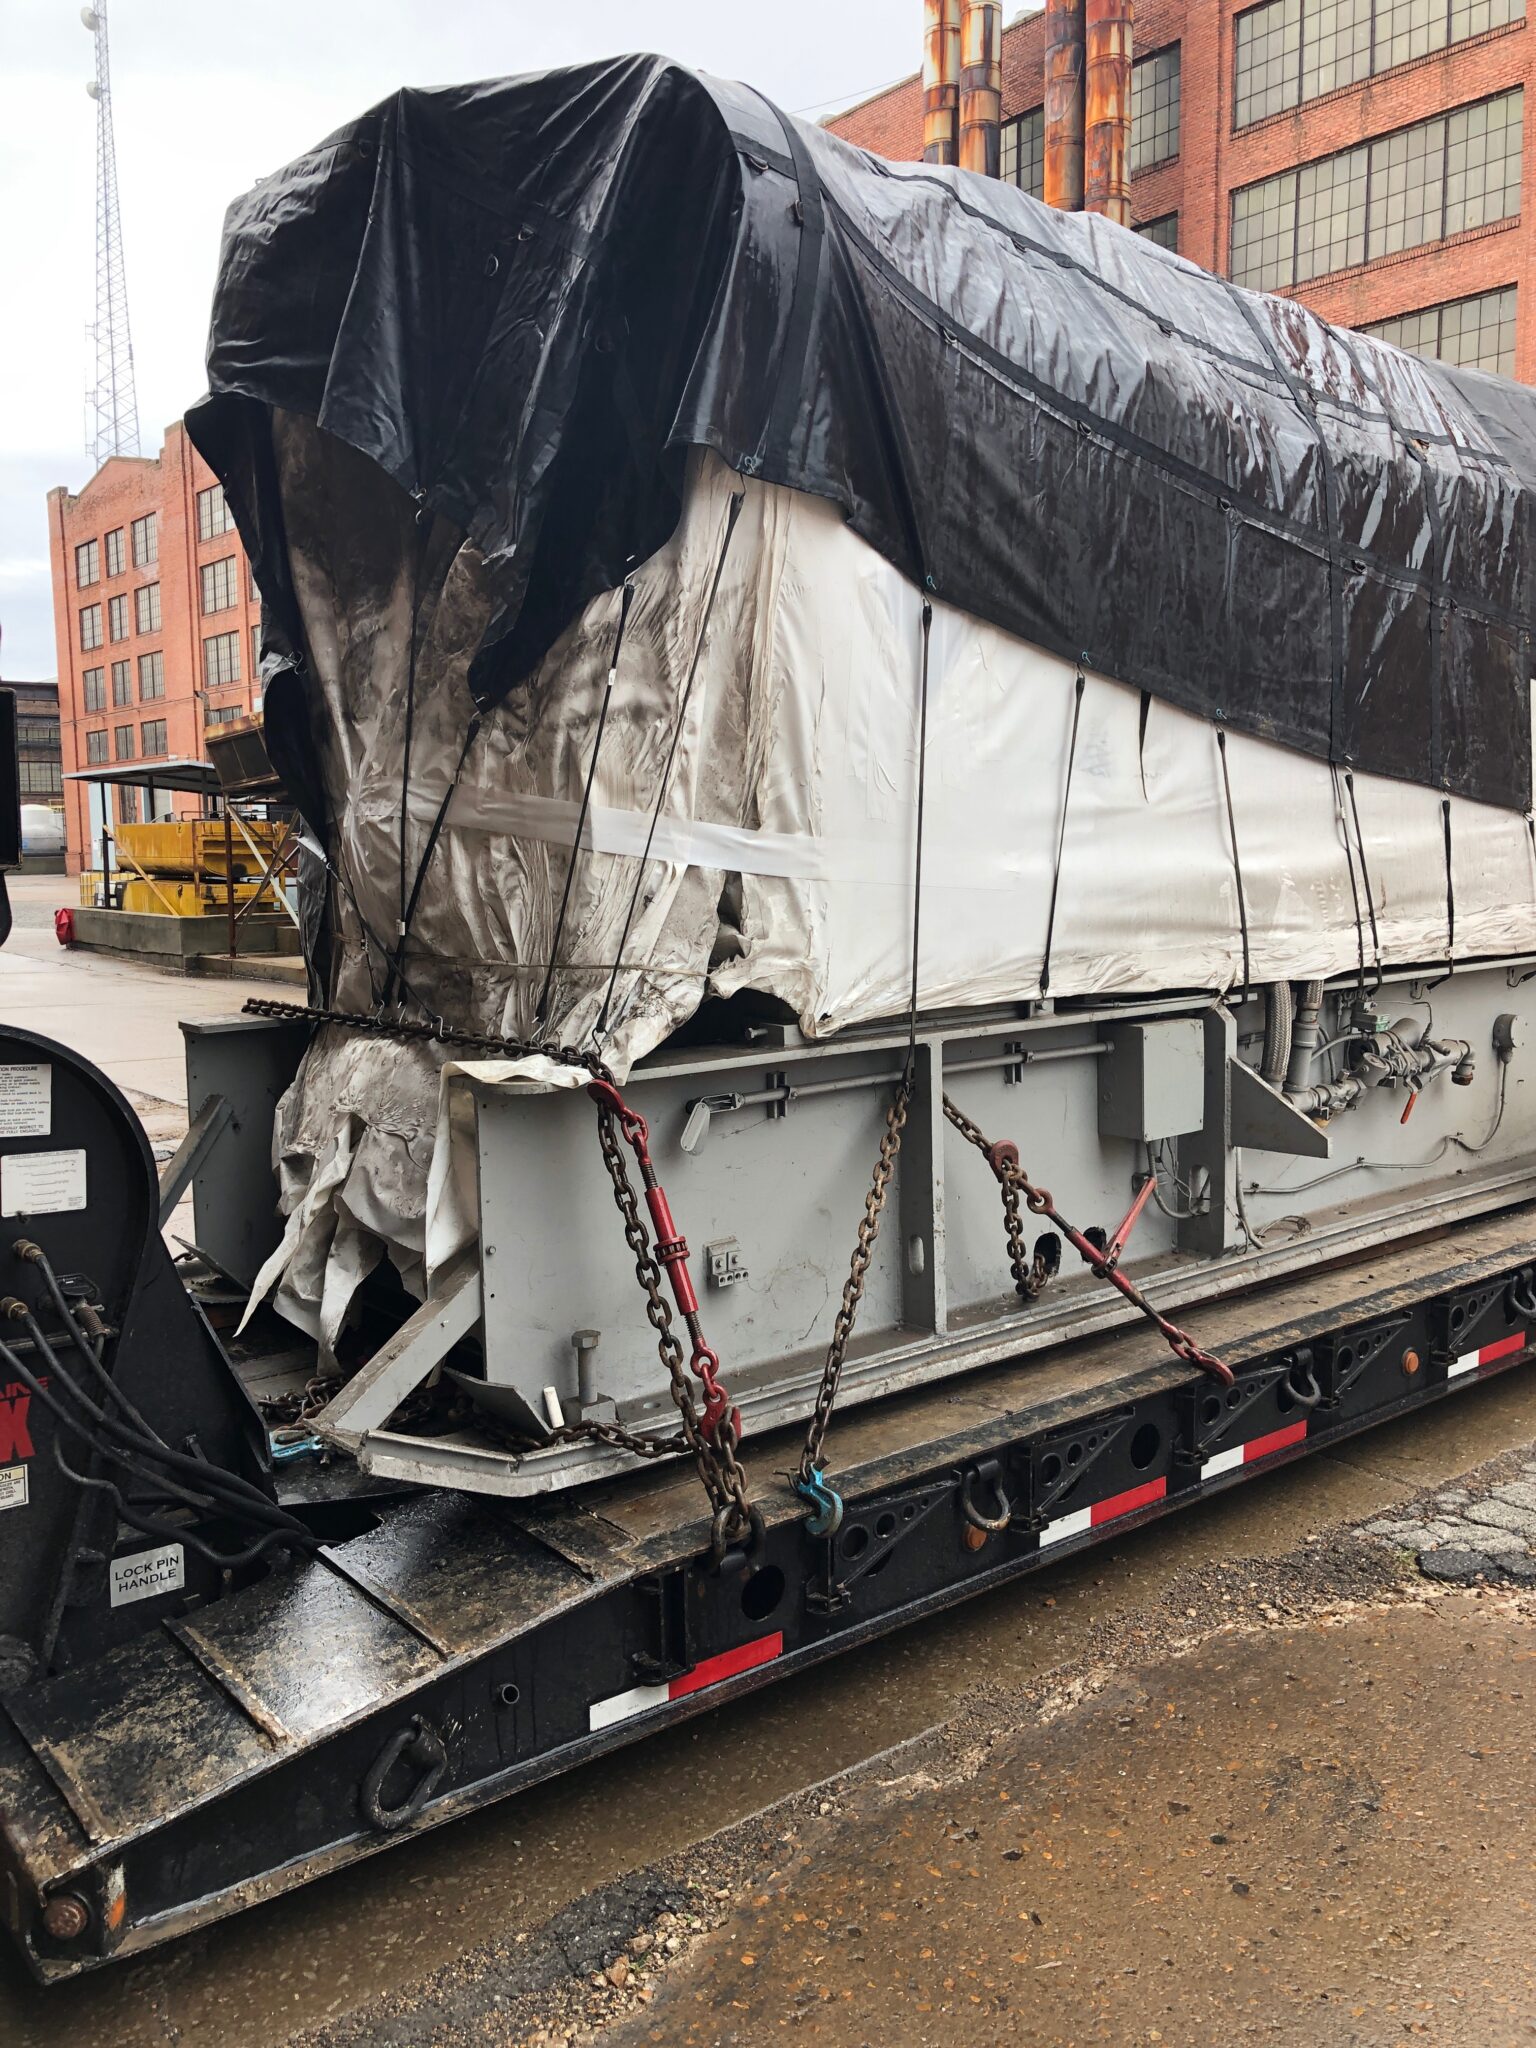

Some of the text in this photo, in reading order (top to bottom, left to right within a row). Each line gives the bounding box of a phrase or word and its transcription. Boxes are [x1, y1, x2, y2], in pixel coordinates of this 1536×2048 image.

[115, 1556, 178, 1580] LOCK PIN
[119, 1569, 176, 1592] HANDLE
